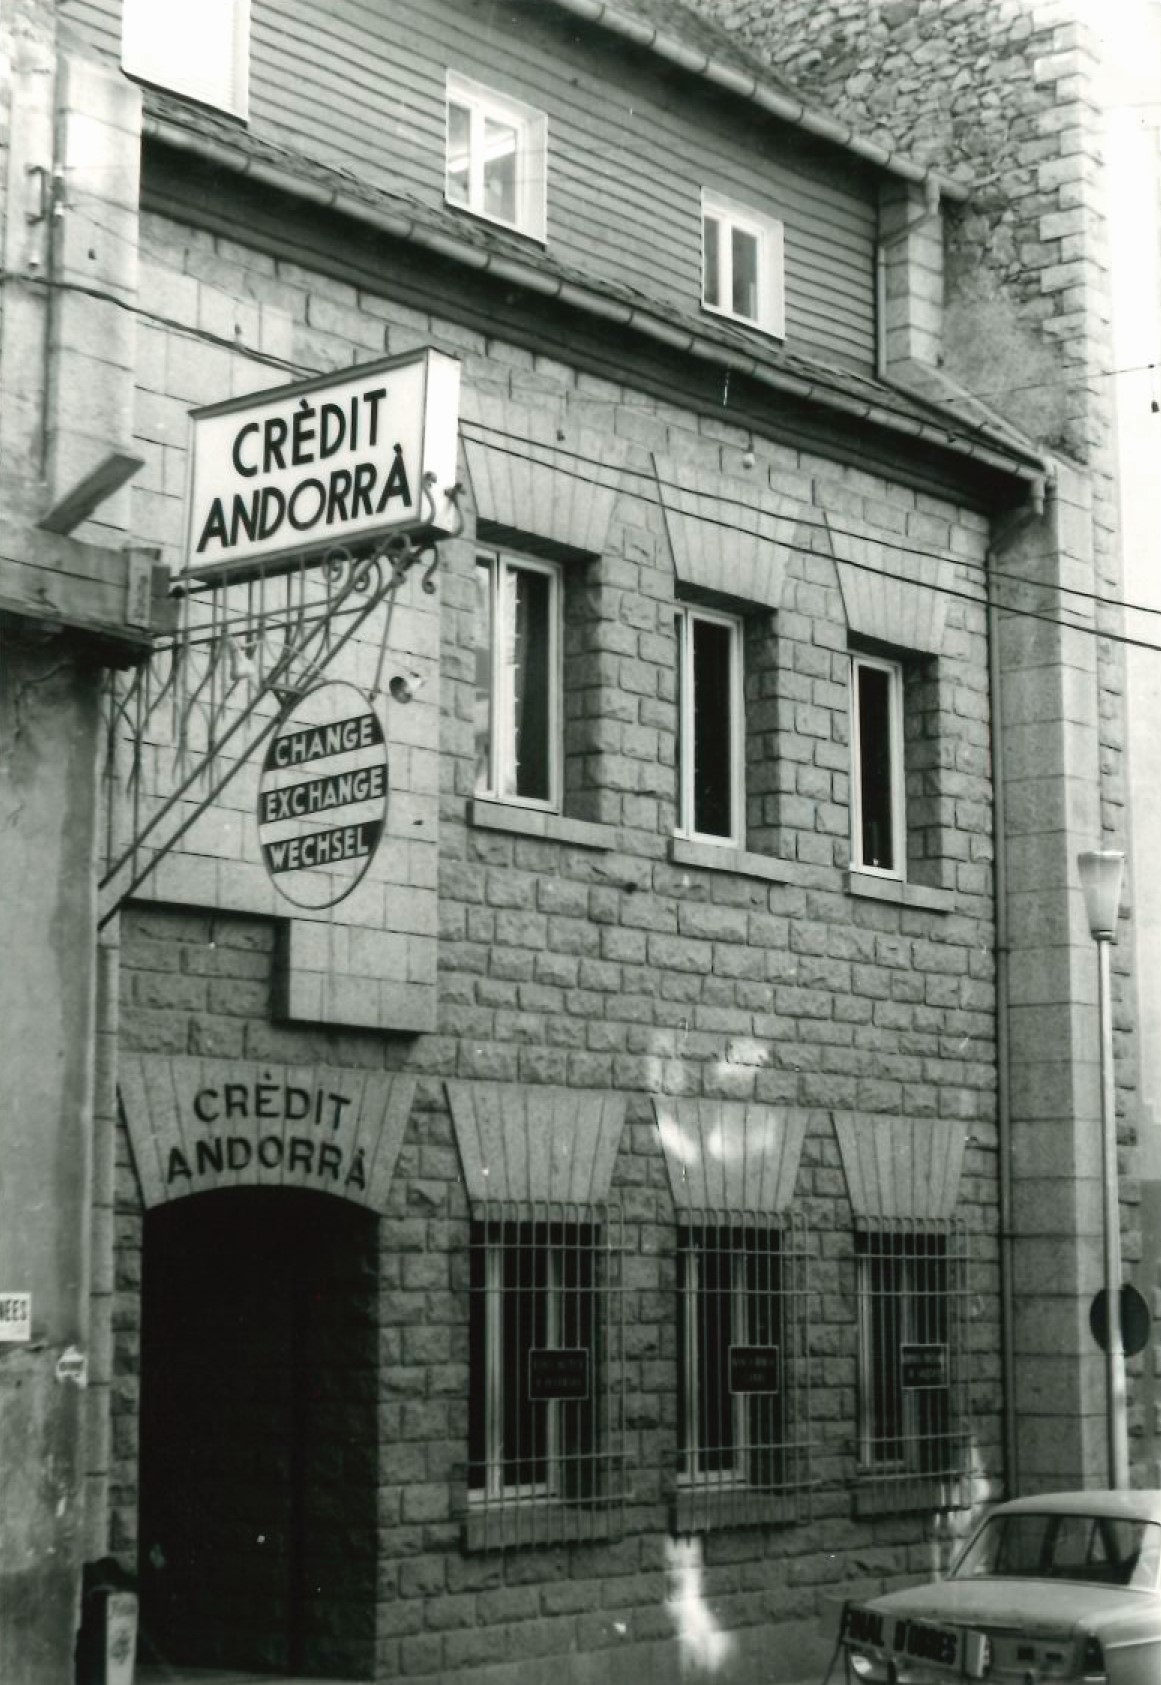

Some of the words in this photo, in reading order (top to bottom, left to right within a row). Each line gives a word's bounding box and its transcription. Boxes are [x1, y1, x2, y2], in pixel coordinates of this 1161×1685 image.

[232, 388, 387, 478] CRÈDIT
[196, 443, 413, 553] ANDORRÀ
[275, 716, 373, 766] CHANGE
[266, 767, 383, 822] EXCHANGE
[269, 827, 369, 869] WECHSEL
[193, 1070, 352, 1130] CRÈDIT
[167, 1136, 366, 1191] ANDORRÀ
